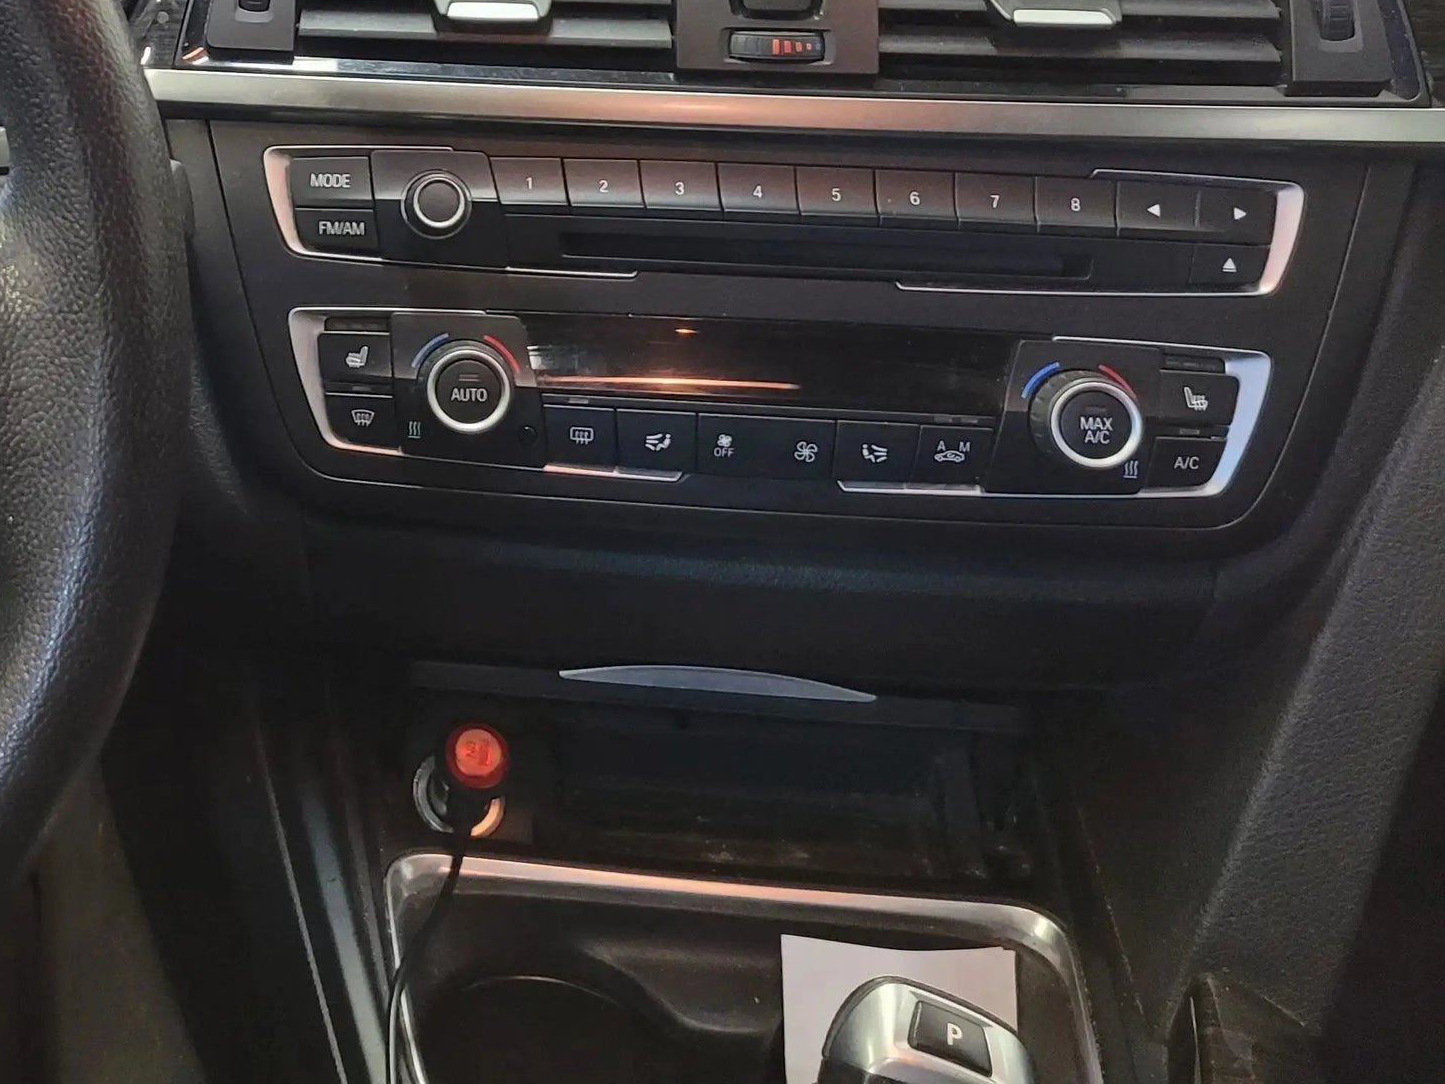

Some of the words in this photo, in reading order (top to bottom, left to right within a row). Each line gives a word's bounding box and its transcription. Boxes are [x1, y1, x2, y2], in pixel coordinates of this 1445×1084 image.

[310, 173, 350, 189] MODE
[525, 177, 534, 189] 1
[599, 179, 609, 193] 2
[675, 182, 685, 196] 3
[753, 185, 763, 199] 4
[831, 188, 842, 202] 5
[909, 191, 921, 205] 6
[990, 195, 1001, 208] 7
[1070, 198, 1081, 211] 8
[319, 221, 365, 236] FM/AM
[451, 387, 488, 403] AUTO
[1080, 416, 1113, 431] MAX
[1084, 430, 1111, 444] A/C
[713, 448, 735, 458] OFF
[937, 441, 946, 453] A
[959, 442, 971, 453] M
[1174, 456, 1199, 471] A/C
[946, 1022, 963, 1046] P
